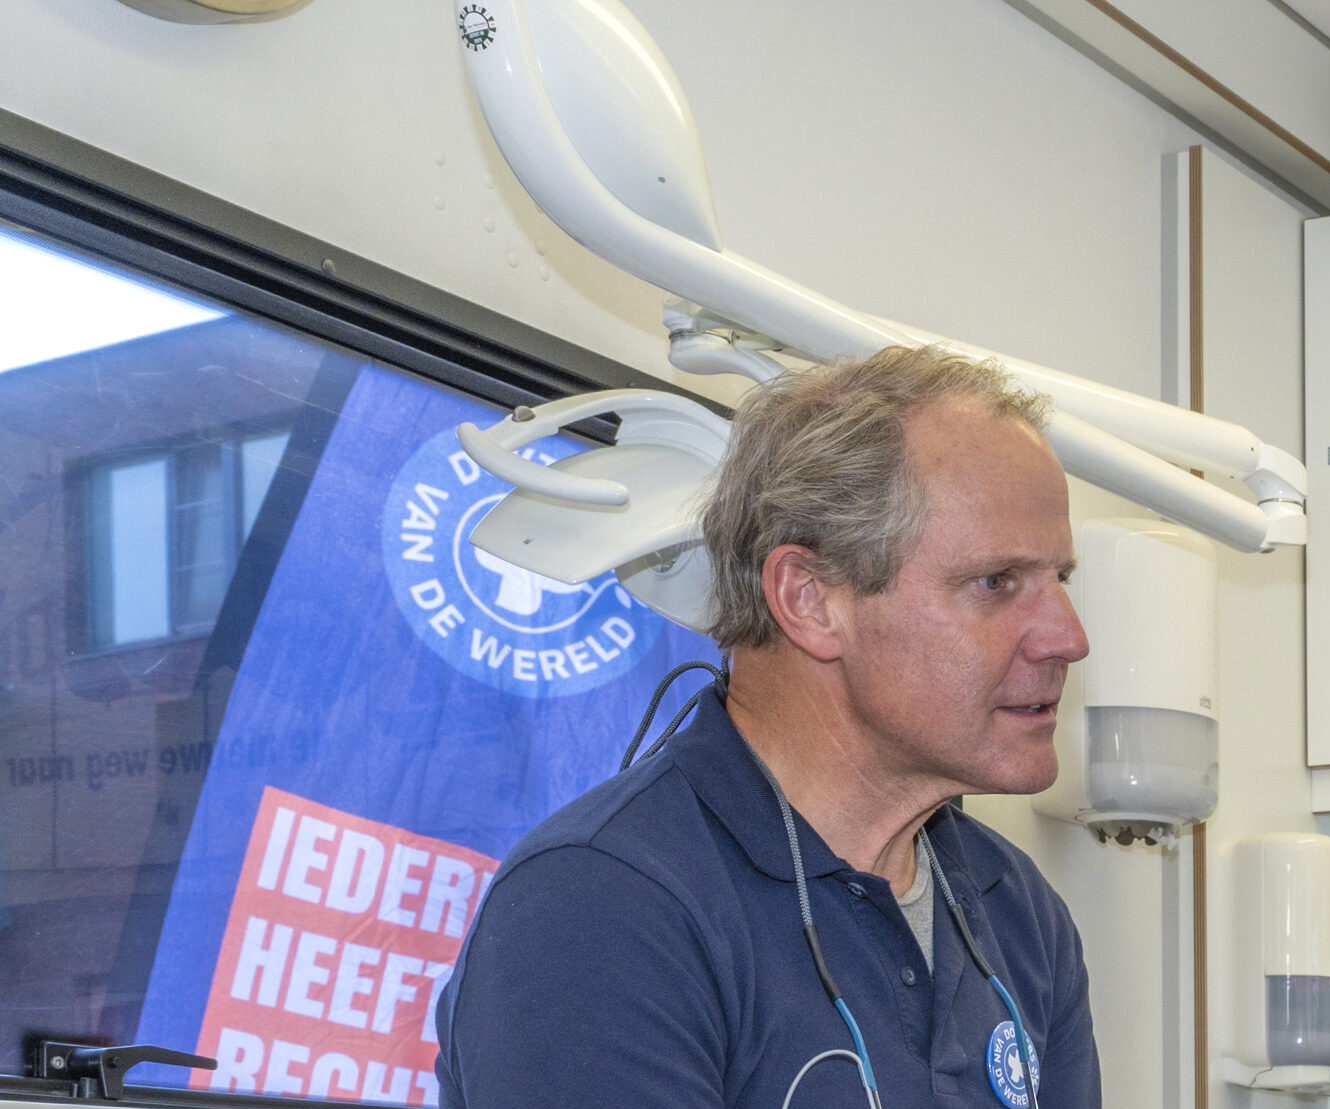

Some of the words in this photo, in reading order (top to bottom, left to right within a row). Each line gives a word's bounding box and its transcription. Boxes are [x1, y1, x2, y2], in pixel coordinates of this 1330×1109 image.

[401, 482, 449, 562] VAN
[410, 578, 465, 637] DE
[470, 616, 635, 681] WERELD
[994, 1038, 1004, 1063] VAN
[995, 1069, 1006, 1087] DE
[1004, 1085, 1029, 1106] WERE
